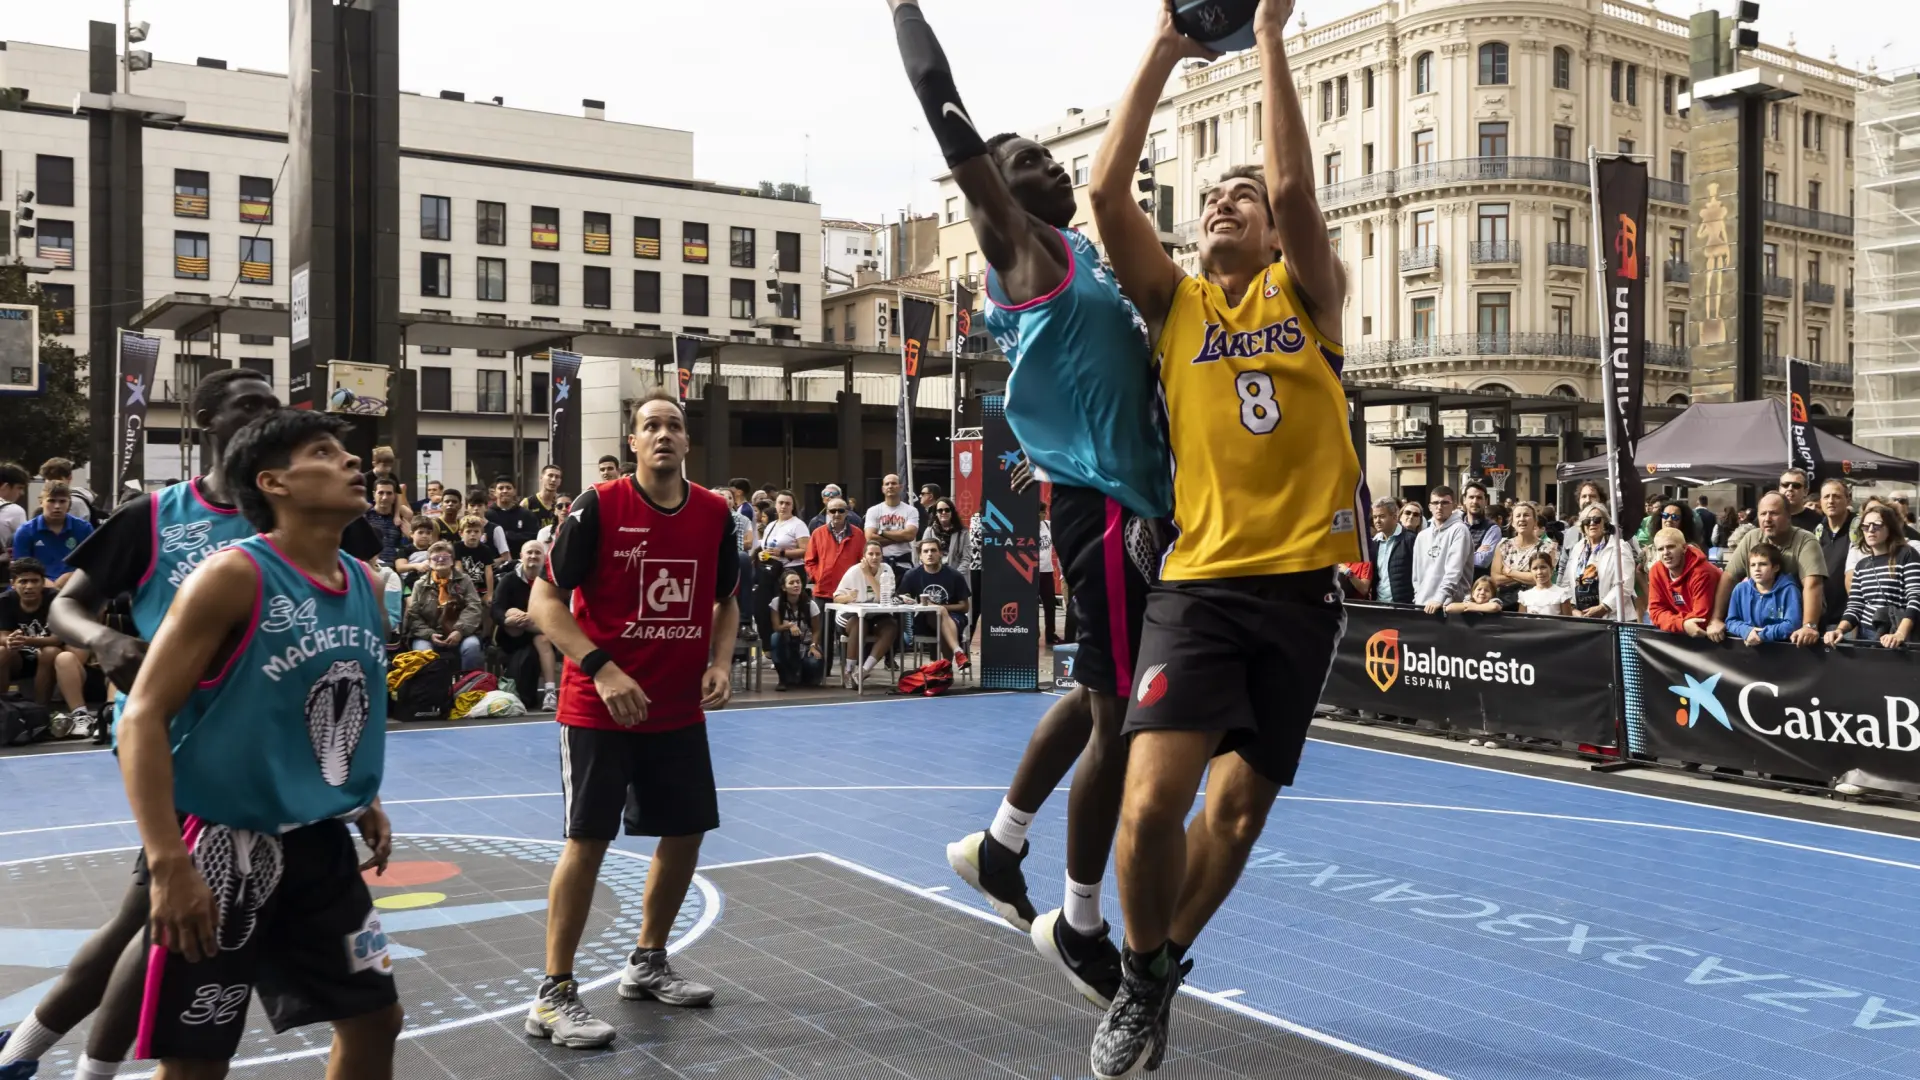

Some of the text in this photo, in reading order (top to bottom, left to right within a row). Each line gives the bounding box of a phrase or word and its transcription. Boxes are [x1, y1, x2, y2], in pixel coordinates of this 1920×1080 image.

[1191, 316, 1306, 364] LAKERS
[1235, 369, 1282, 435] 8
[160, 520, 212, 553] 23
[984, 537, 1036, 547] PLAZA
[261, 595, 318, 633] 34
[261, 625, 359, 682] MACHETE
[1404, 675, 1451, 691] ESPAÑA
[1738, 681, 1920, 752] CaixaB
[179, 983, 249, 1025] 32
